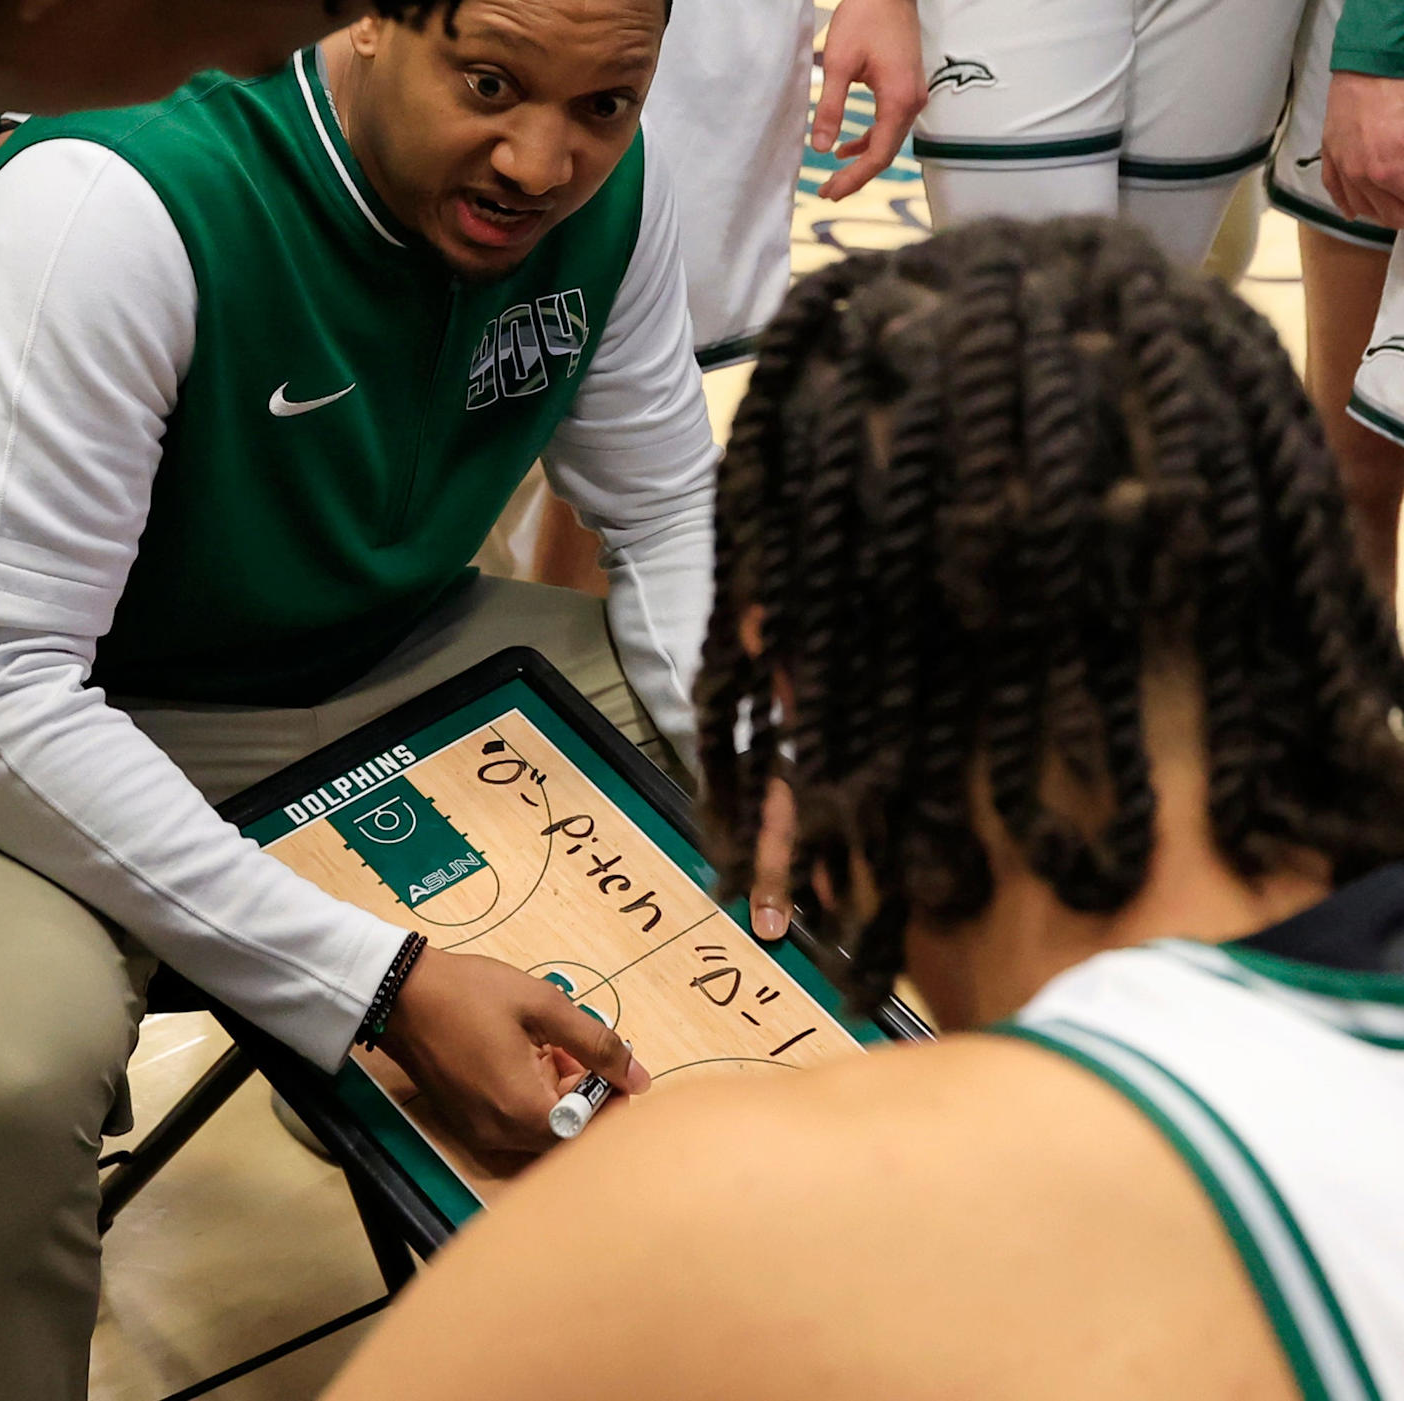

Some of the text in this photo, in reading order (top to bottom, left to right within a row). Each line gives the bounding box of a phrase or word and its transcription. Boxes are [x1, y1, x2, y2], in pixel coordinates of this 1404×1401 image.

[465, 287, 590, 412] 904
[283, 743, 417, 826] DOLPHINS
[408, 851, 481, 904] ASUN
